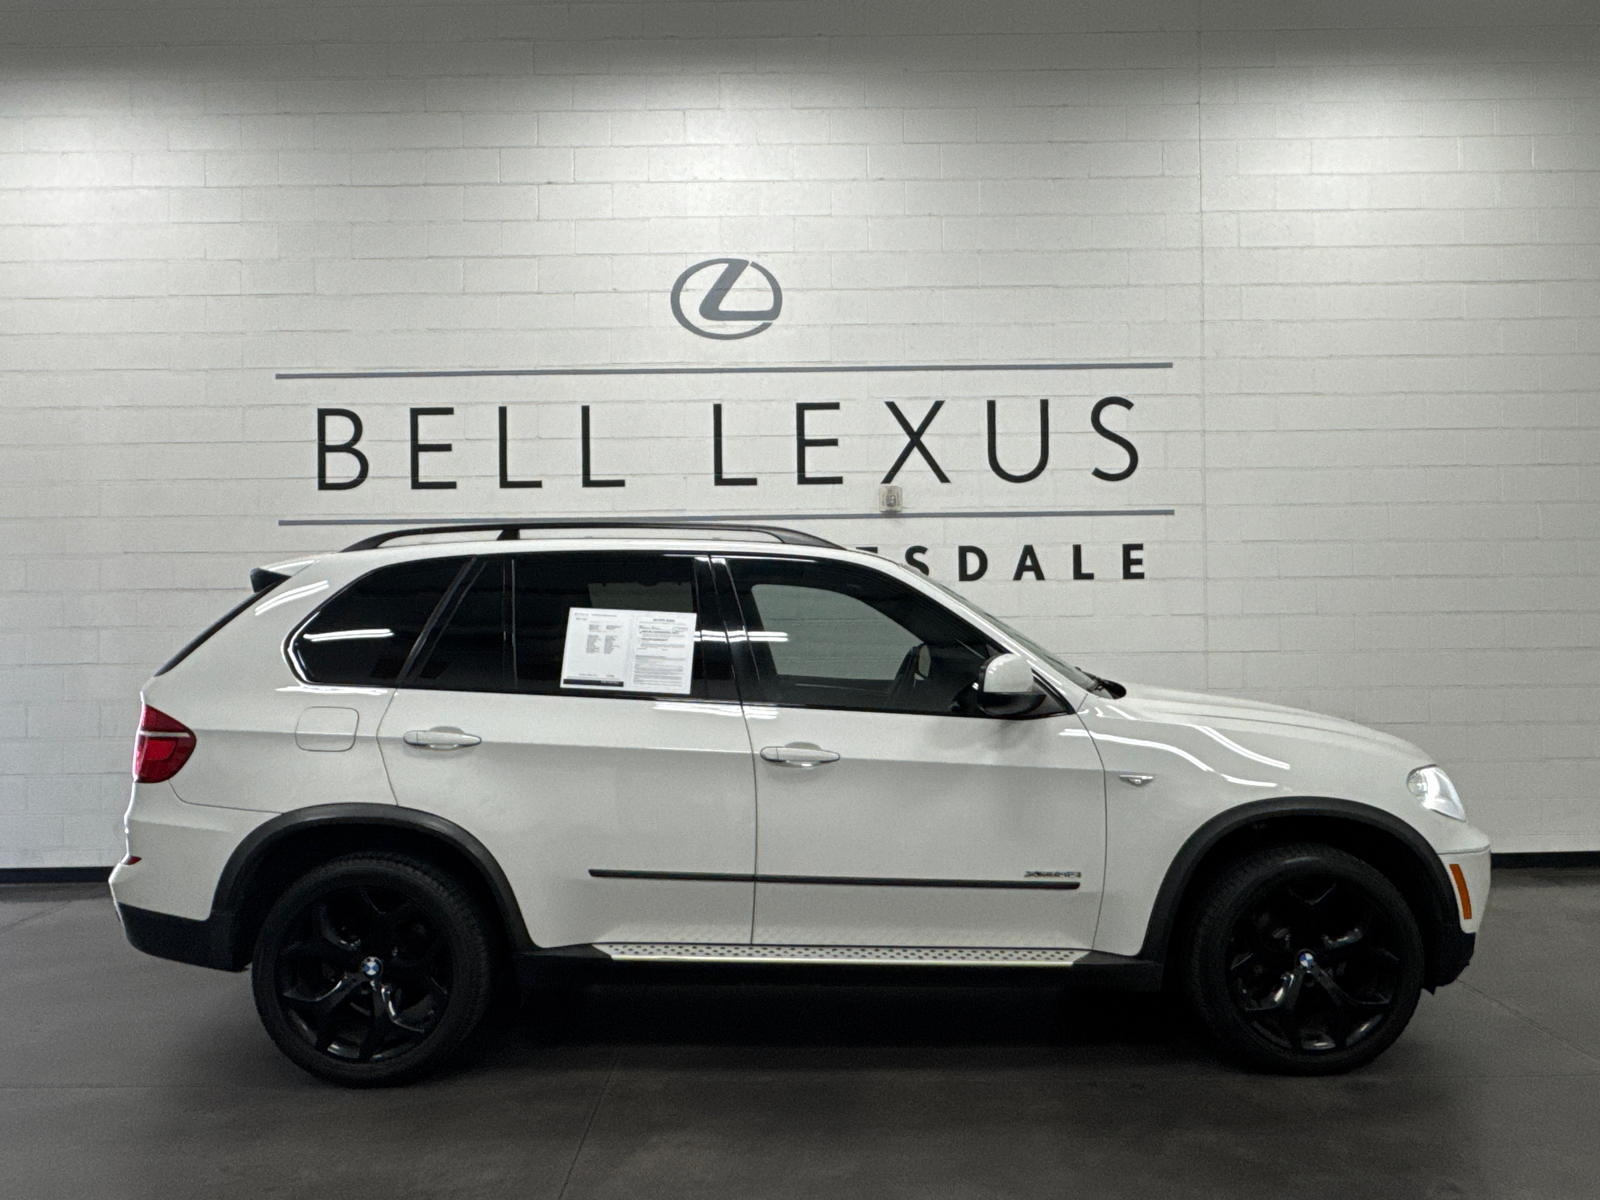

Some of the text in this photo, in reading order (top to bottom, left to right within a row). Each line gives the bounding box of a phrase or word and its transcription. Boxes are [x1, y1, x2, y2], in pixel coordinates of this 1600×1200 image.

[317, 396, 1139, 491] BELL LEXUS
[856, 543, 1146, 582] SDALE
